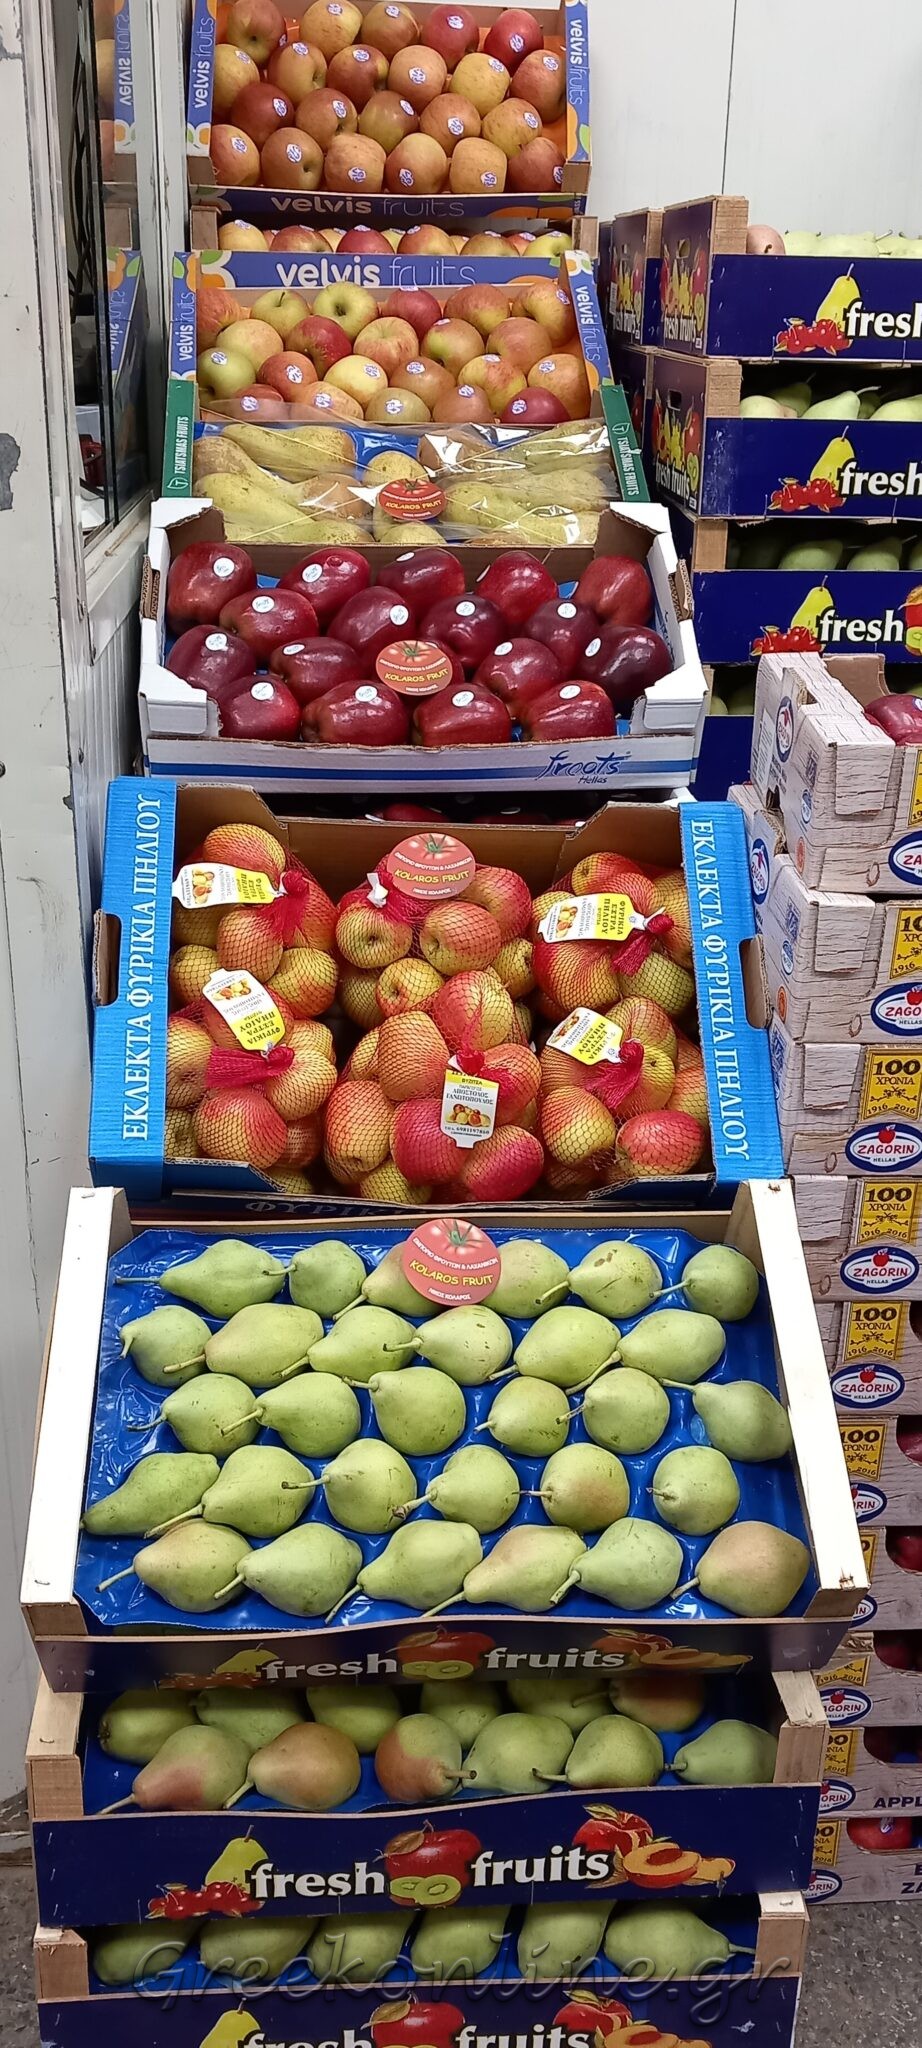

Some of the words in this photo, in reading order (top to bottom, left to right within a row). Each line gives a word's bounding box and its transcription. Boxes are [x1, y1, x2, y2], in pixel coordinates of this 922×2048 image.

[195, 17, 214, 57] fruits
[570, 19, 587, 65] velvis
[193, 61, 210, 108] velvis
[569, 65, 589, 104] fruits
[271, 197, 372, 214] velvis
[383, 198, 465, 217] fruits
[275, 256, 380, 287] velvis
[389, 256, 475, 287] fruits
[576, 286, 597, 325] velvis
[175, 324, 194, 361] velvis
[582, 325, 601, 362] fruits
[176, 416, 189, 438] FRUITS
[174, 438, 188, 474] TSIATSMAS
[625, 471, 639, 496] FRUITS
[840, 461, 922, 496] fresh
[386, 502, 421, 510] KOLAROS
[422, 500, 441, 509] FRUIT
[820, 608, 904, 642] fresh
[384, 672, 425, 682] KOLAROS
[426, 668, 448, 681] FRUIT
[537, 750, 631, 780] froots
[577, 776, 607, 784] Hellas
[132, 794, 161, 898] ΠΗΛΙΟΥ
[394, 869, 439, 883] KOLAROS
[442, 870, 470, 883] FRUIT
[691, 819, 720, 930] ΕΚΛΕΚΤΑ
[602, 898, 611, 934] ΠΗΛΙΟΥ
[126, 903, 156, 1008] ΦΥΡΙΚΙΑ
[894, 961, 915, 974] 1916
[701, 934, 734, 1043] ΦΥΡΙΚΙΑ
[240, 1011, 276, 1032] ΠΗΛΙΟΥ
[885, 1007, 922, 1017] ZAGO
[247, 1027, 281, 1045] ΦΥΡΙΚΙΑ
[122, 1012, 153, 1141] ΕΚΛΕΚΤΑ
[873, 1059, 920, 1075] 100
[876, 1077, 915, 1085] ΧΡΟΝΙΑ
[453, 1089, 489, 1098] ΑΠΟΣΤΟΛΟΣ
[713, 1049, 750, 1160] ΠΗΛΙΟΥ
[867, 1103, 888, 1114] 1916
[894, 1103, 916, 1114] 2016
[857, 1145, 914, 1154] ZAGORIN
[866, 1187, 912, 1203] 100
[868, 1203, 907, 1212] ΧΡΟΝΙΑ
[860, 1228, 881, 1239] 1916
[886, 1228, 908, 1239] 2016
[410, 1260, 459, 1285] KOLAROS
[462, 1275, 494, 1286] FRUIT
[853, 1267, 908, 1277] ZAGORIN
[852, 1307, 897, 1322] 100
[855, 1322, 893, 1330] ΧΡΟΝΙΑ
[847, 1345, 868, 1357] 1916
[873, 1345, 893, 1357] 2016
[840, 1383, 894, 1393] ZAGORIN
[856, 1467, 876, 1475] 2016
[262, 1654, 397, 1680] fresh
[484, 1648, 625, 1670] fruits
[873, 1796, 922, 1809] APPL
[250, 1862, 385, 1898] fresh
[471, 1845, 611, 1887] fruits
[809, 1883, 833, 1891] ORIN
